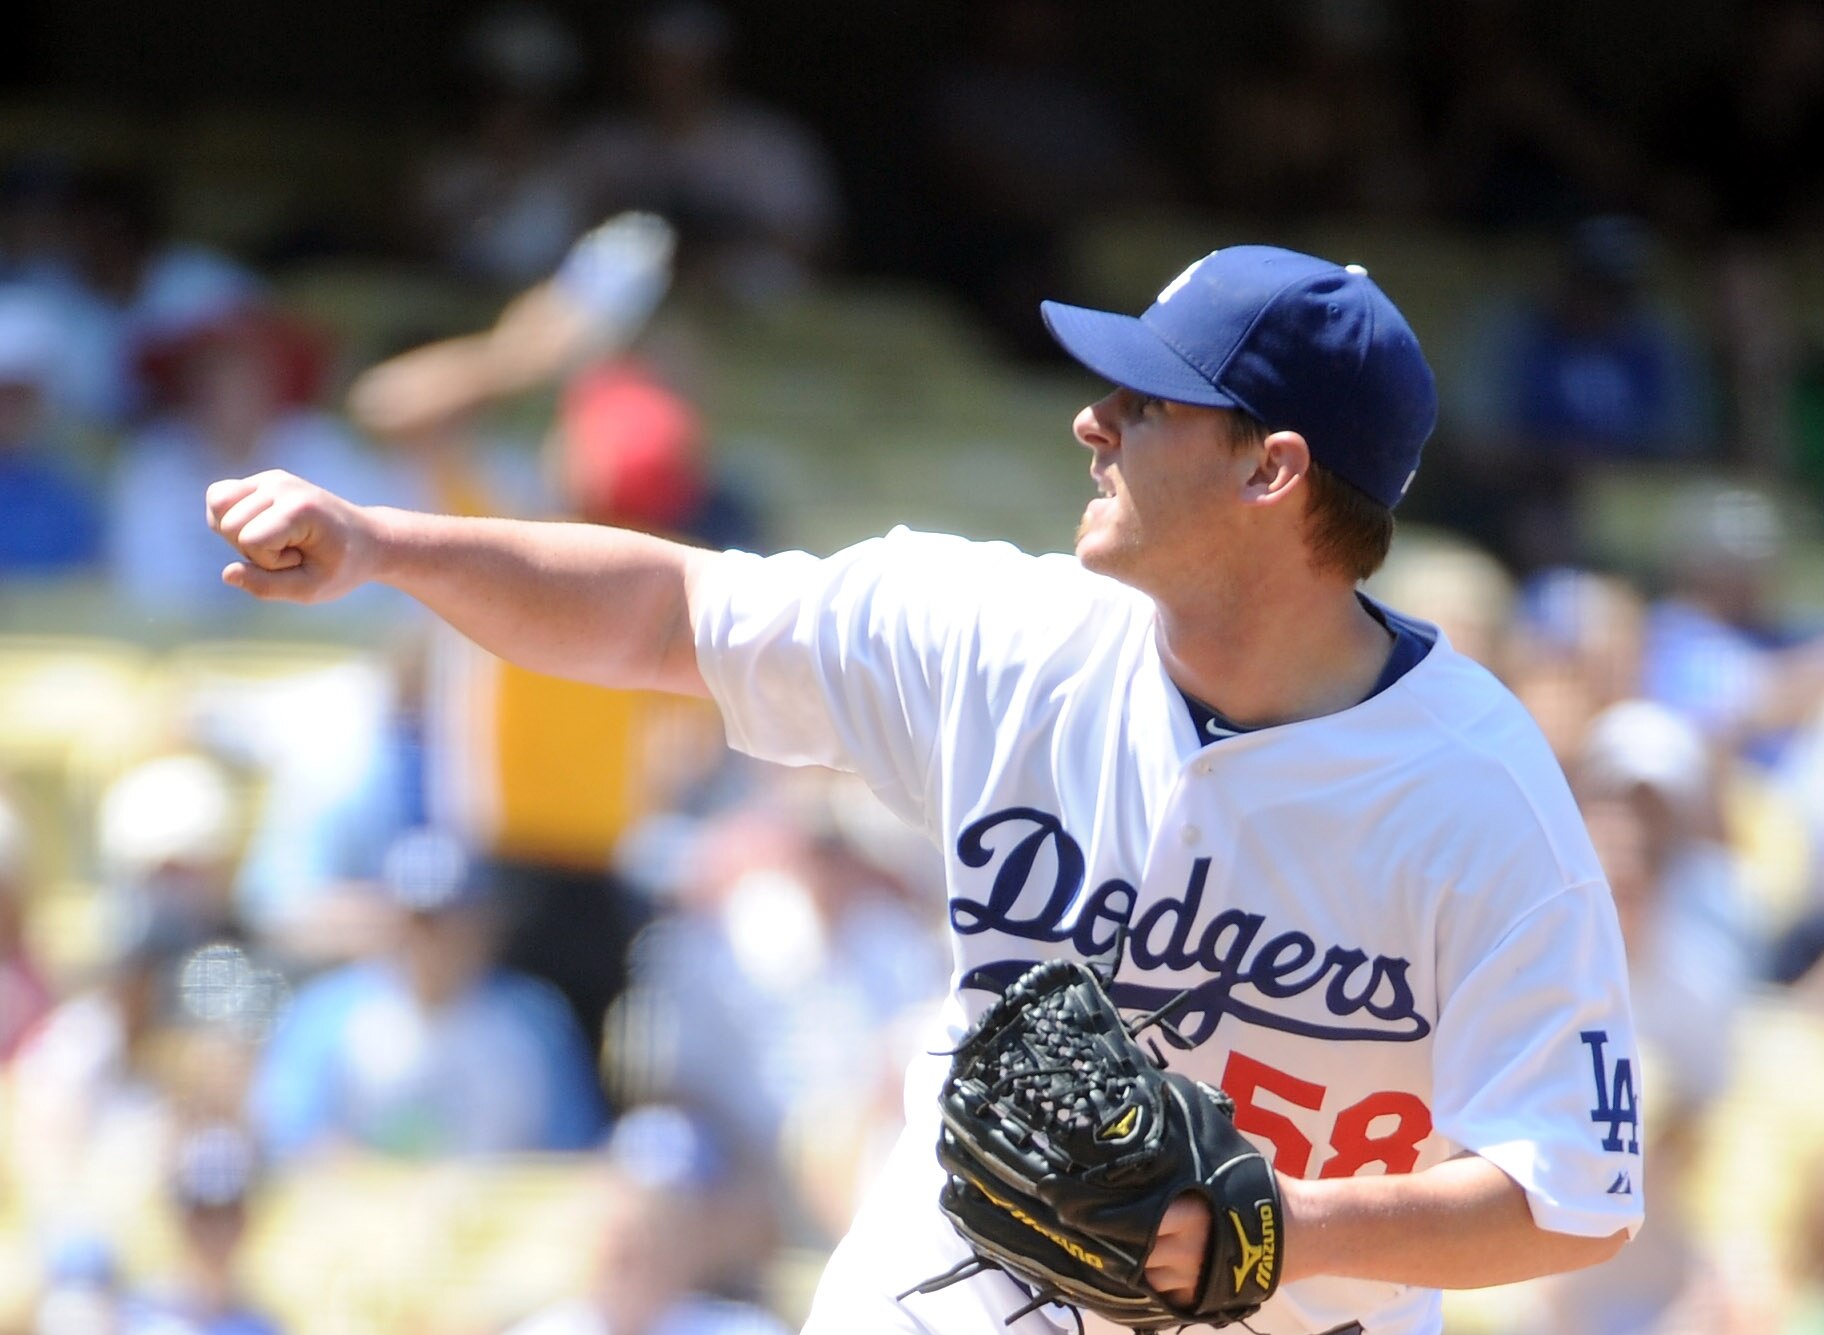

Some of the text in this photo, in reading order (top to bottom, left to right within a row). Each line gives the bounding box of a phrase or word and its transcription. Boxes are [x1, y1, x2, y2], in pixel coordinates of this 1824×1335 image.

[950, 807, 1430, 1046] Dodgers
[1221, 1050, 1432, 1180] 58
[1580, 1030, 1639, 1155] LA
[1256, 1205, 1275, 1290] MIZUNO
